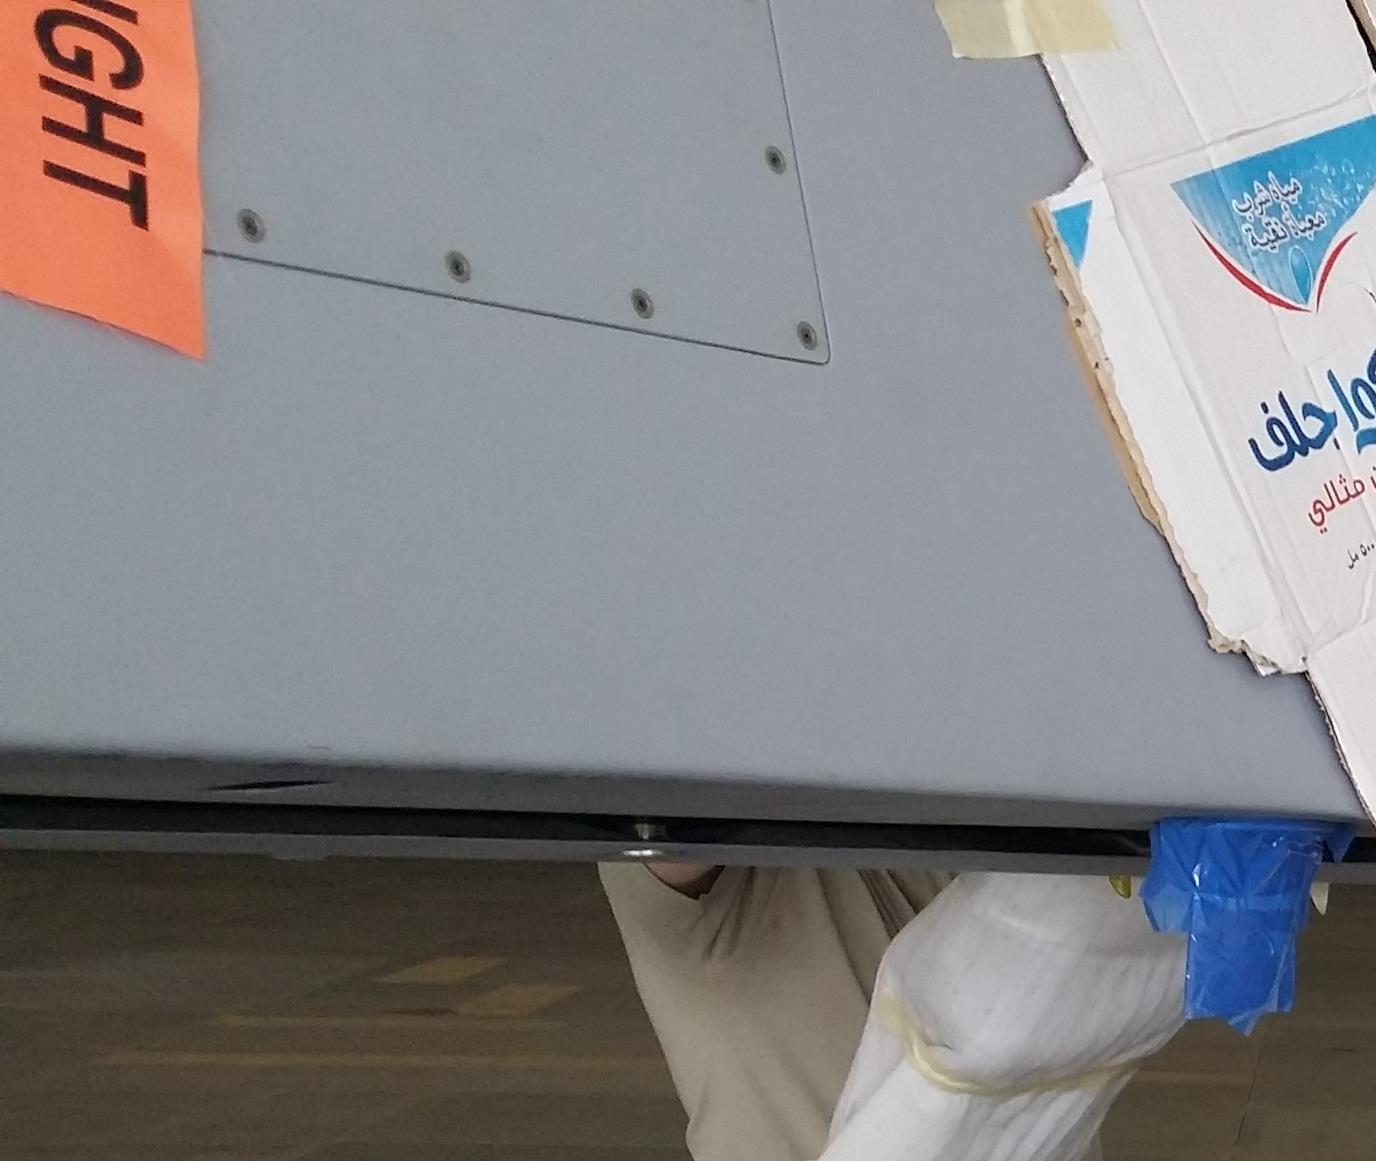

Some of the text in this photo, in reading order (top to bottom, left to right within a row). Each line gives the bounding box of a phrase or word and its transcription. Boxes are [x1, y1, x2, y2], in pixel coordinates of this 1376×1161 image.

[1232, 171, 1301, 220] مياه شرب
[1248, 390, 1341, 472] جلف
[1308, 474, 1365, 534] مثالي
